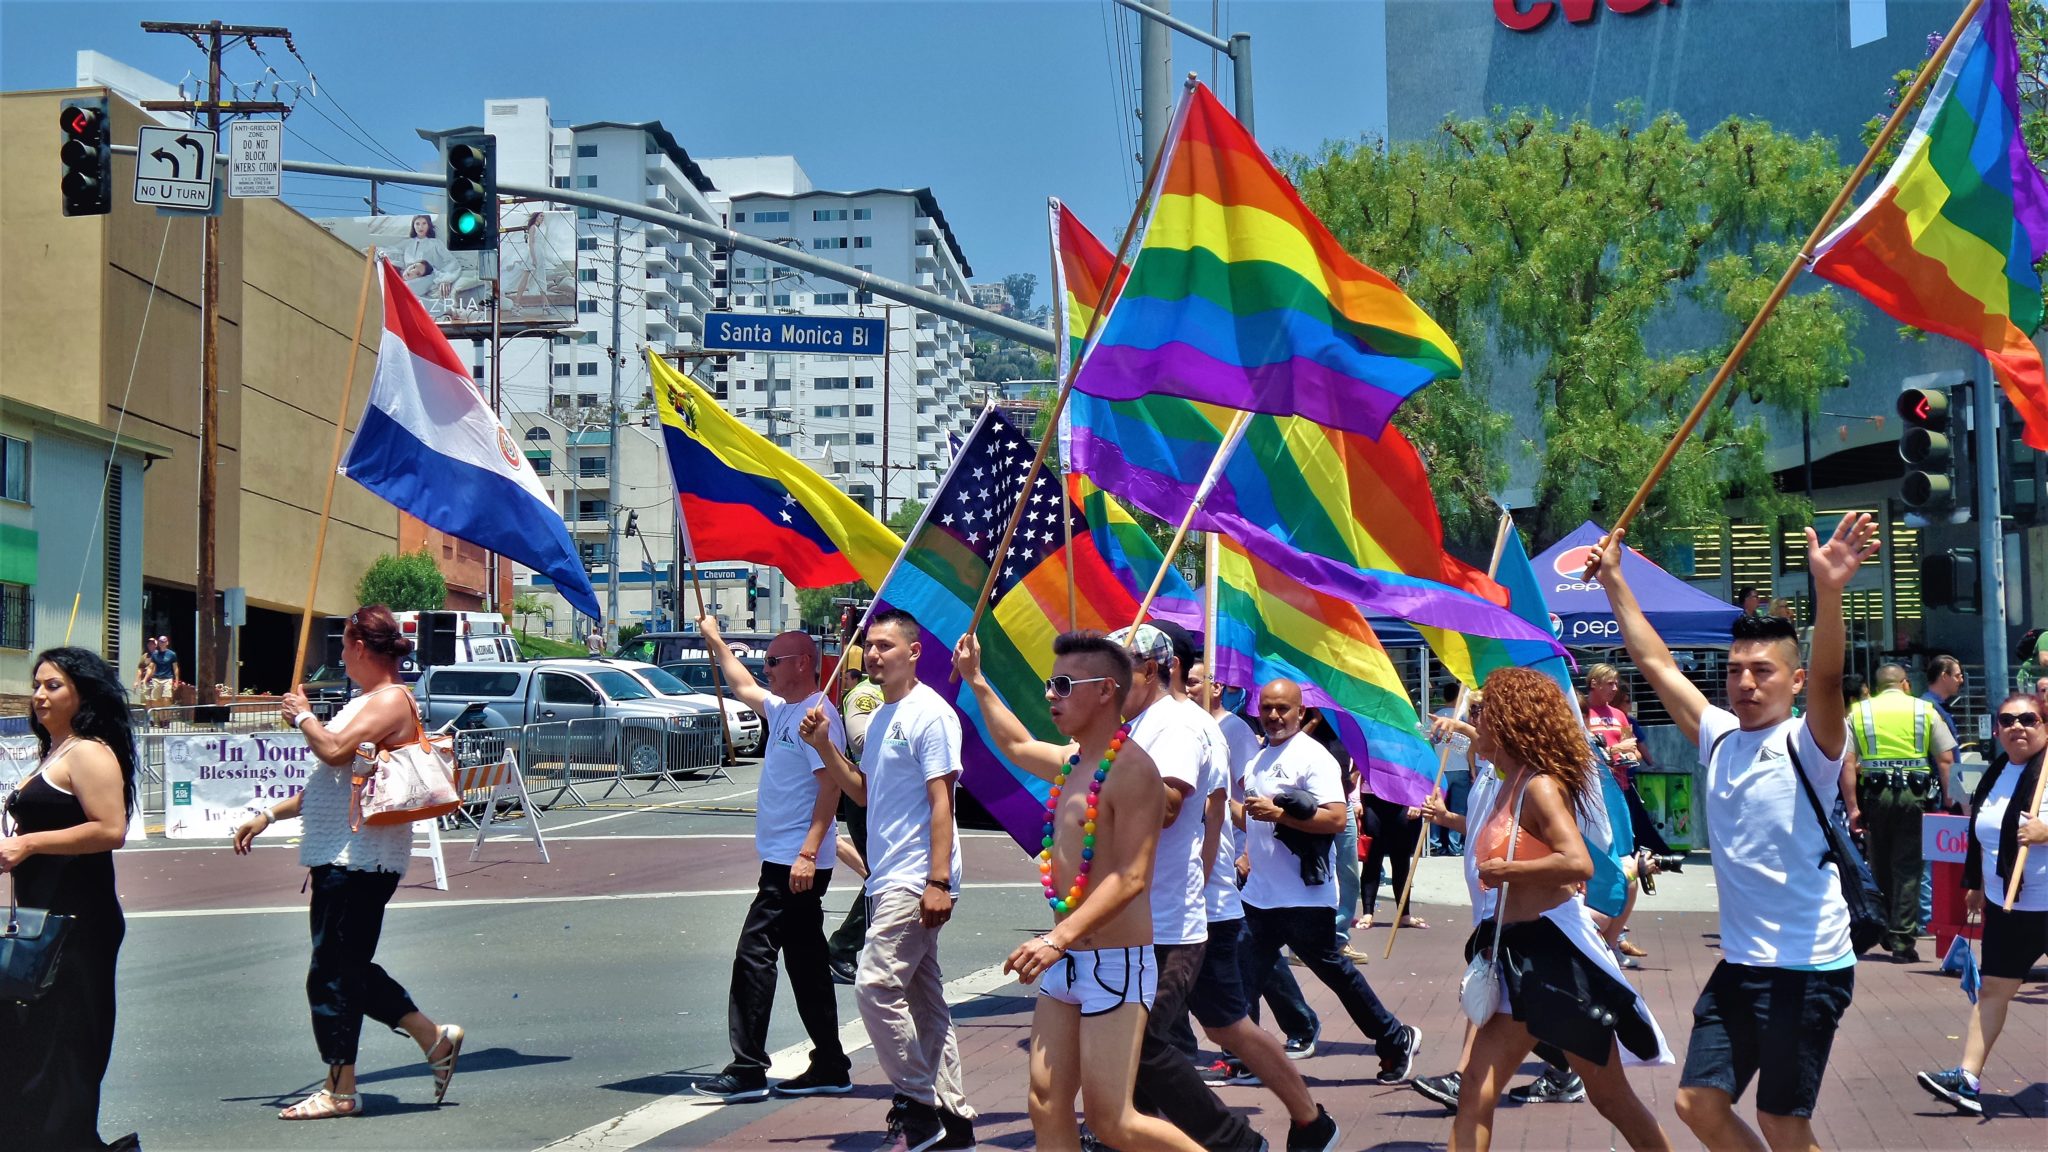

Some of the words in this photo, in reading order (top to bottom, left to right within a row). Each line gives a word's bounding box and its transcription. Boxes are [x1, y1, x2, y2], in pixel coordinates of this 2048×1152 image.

[243, 140, 253, 149] DO
[256, 140, 269, 149] NOT
[245, 151, 266, 161] BLOCK
[141, 185, 156, 196] NO
[160, 184, 173, 199] U
[176, 188, 206, 200] TURN
[720, 321, 772, 343] Santa
[781, 323, 843, 346] Monica
[852, 326, 869, 346] Bl
[704, 570, 736, 579] Chevron
[1555, 582, 1605, 593] pep
[254, 738, 311, 762] Your
[199, 764, 277, 781] Blessings
[284, 764, 305, 779] On
